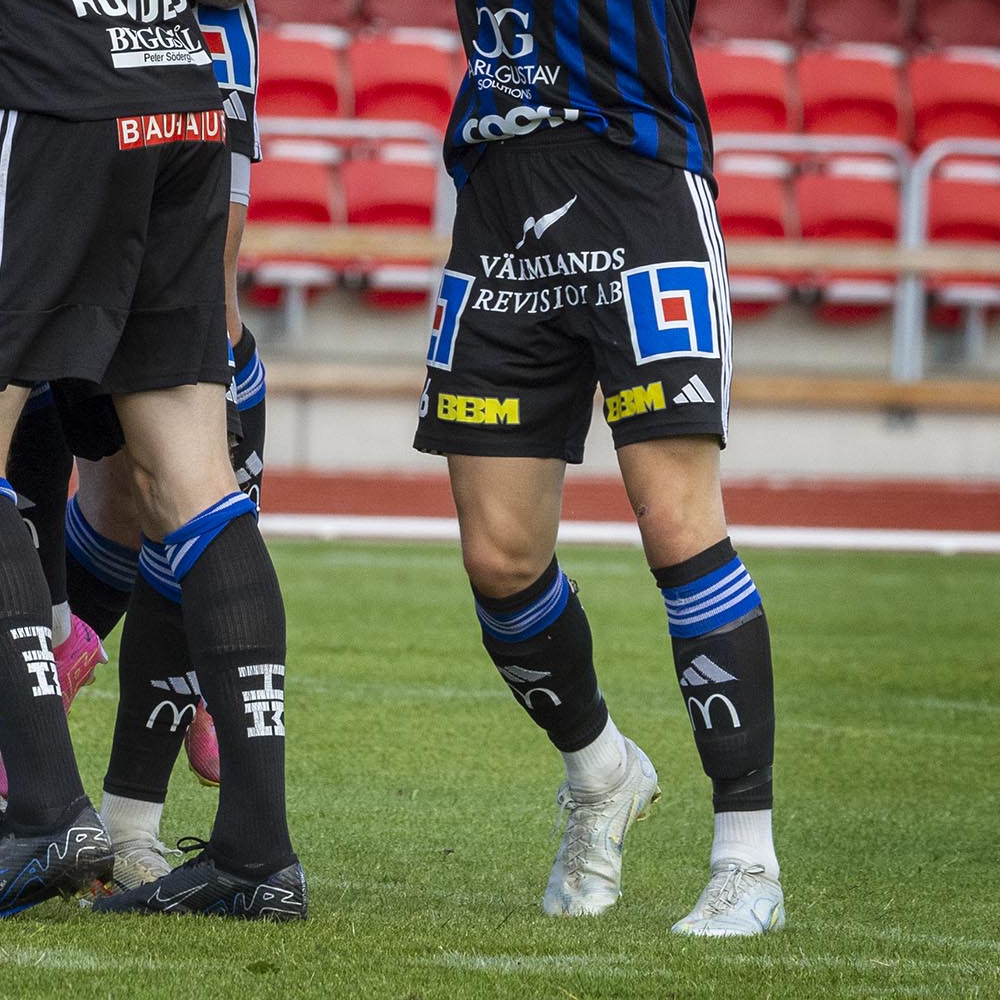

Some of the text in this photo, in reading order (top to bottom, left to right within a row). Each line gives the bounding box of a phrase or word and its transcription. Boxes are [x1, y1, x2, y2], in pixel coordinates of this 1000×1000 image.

[144, 51, 193, 64] Peter Söderg
[478, 79, 532, 100] SOLUTIONS
[595, 281, 622, 306] AB
[437, 392, 520, 425] BBM
[606, 381, 667, 423] BBM
